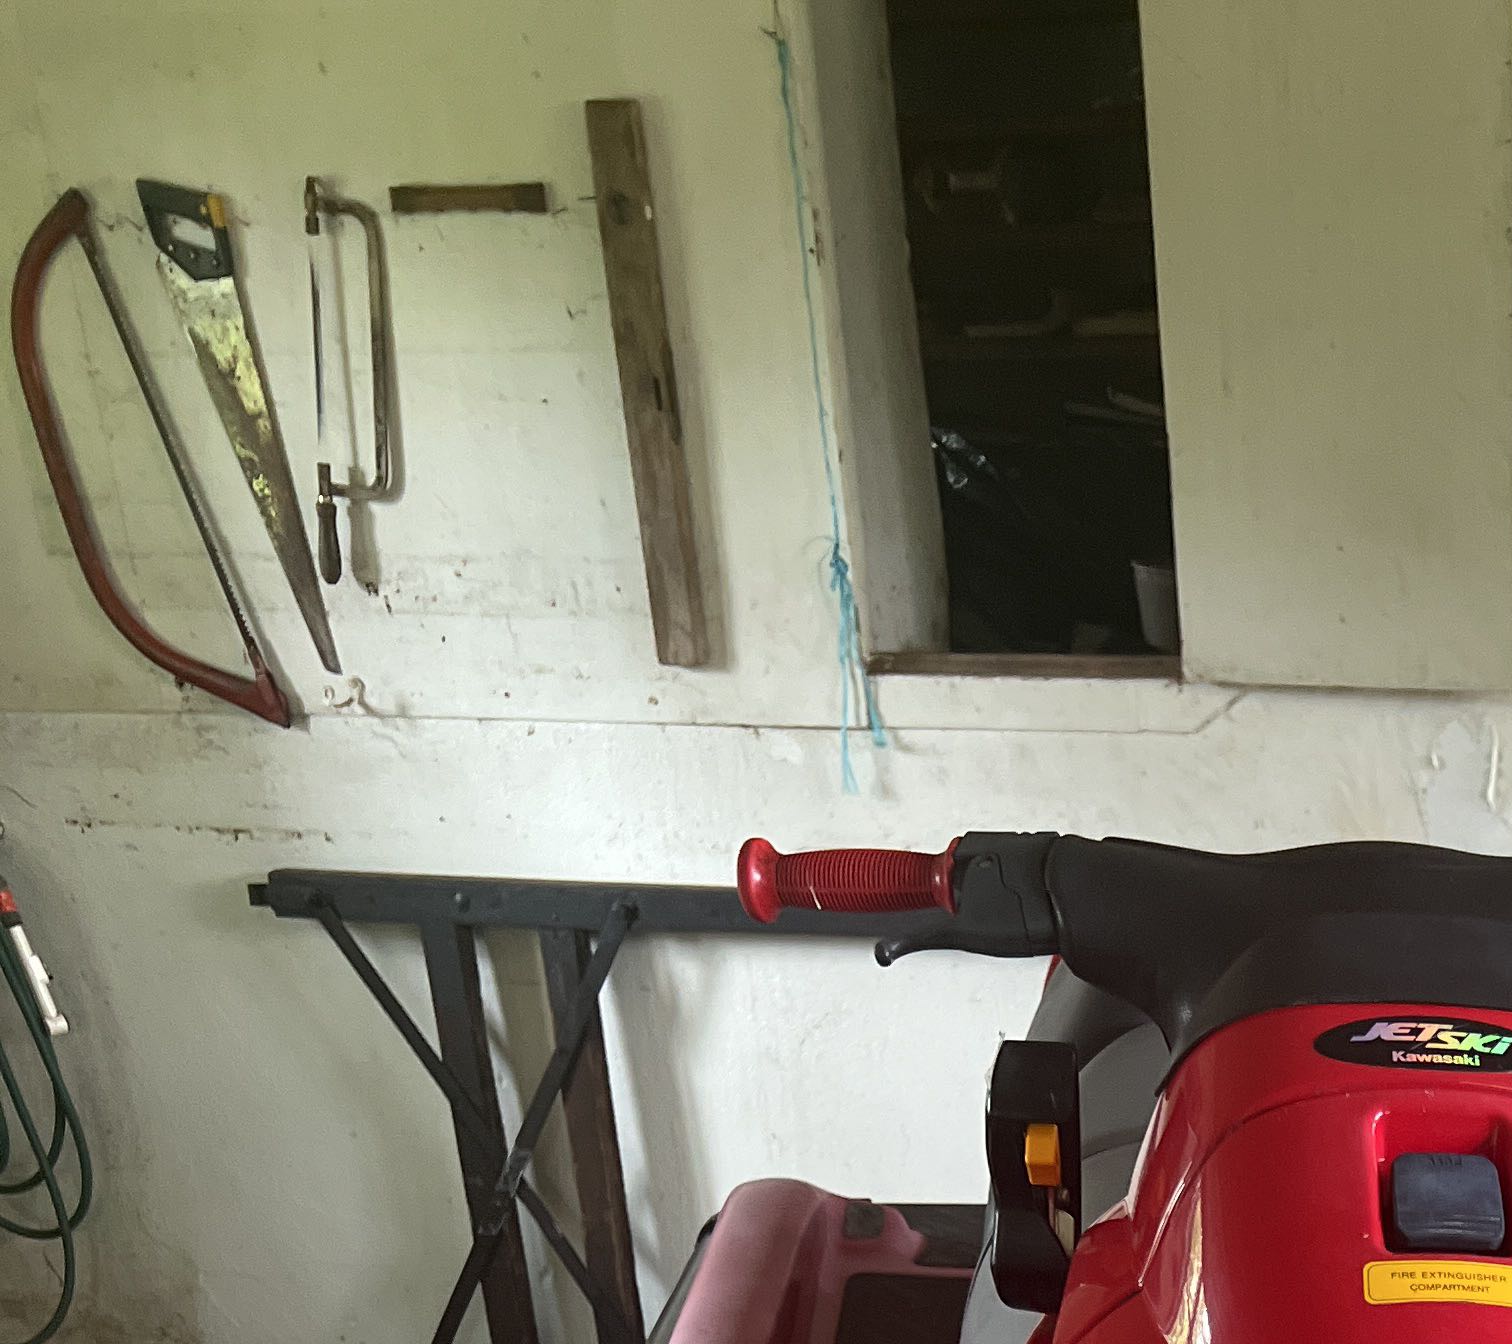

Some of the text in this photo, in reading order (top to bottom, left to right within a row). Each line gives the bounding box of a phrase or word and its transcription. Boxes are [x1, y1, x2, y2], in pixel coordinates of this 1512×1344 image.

[1392, 1050, 1481, 1067] Kawasaki
[1391, 1271, 1507, 1283] FIRE EXTINGUISHER
[1409, 1283, 1491, 1293] COMPARTMENT
